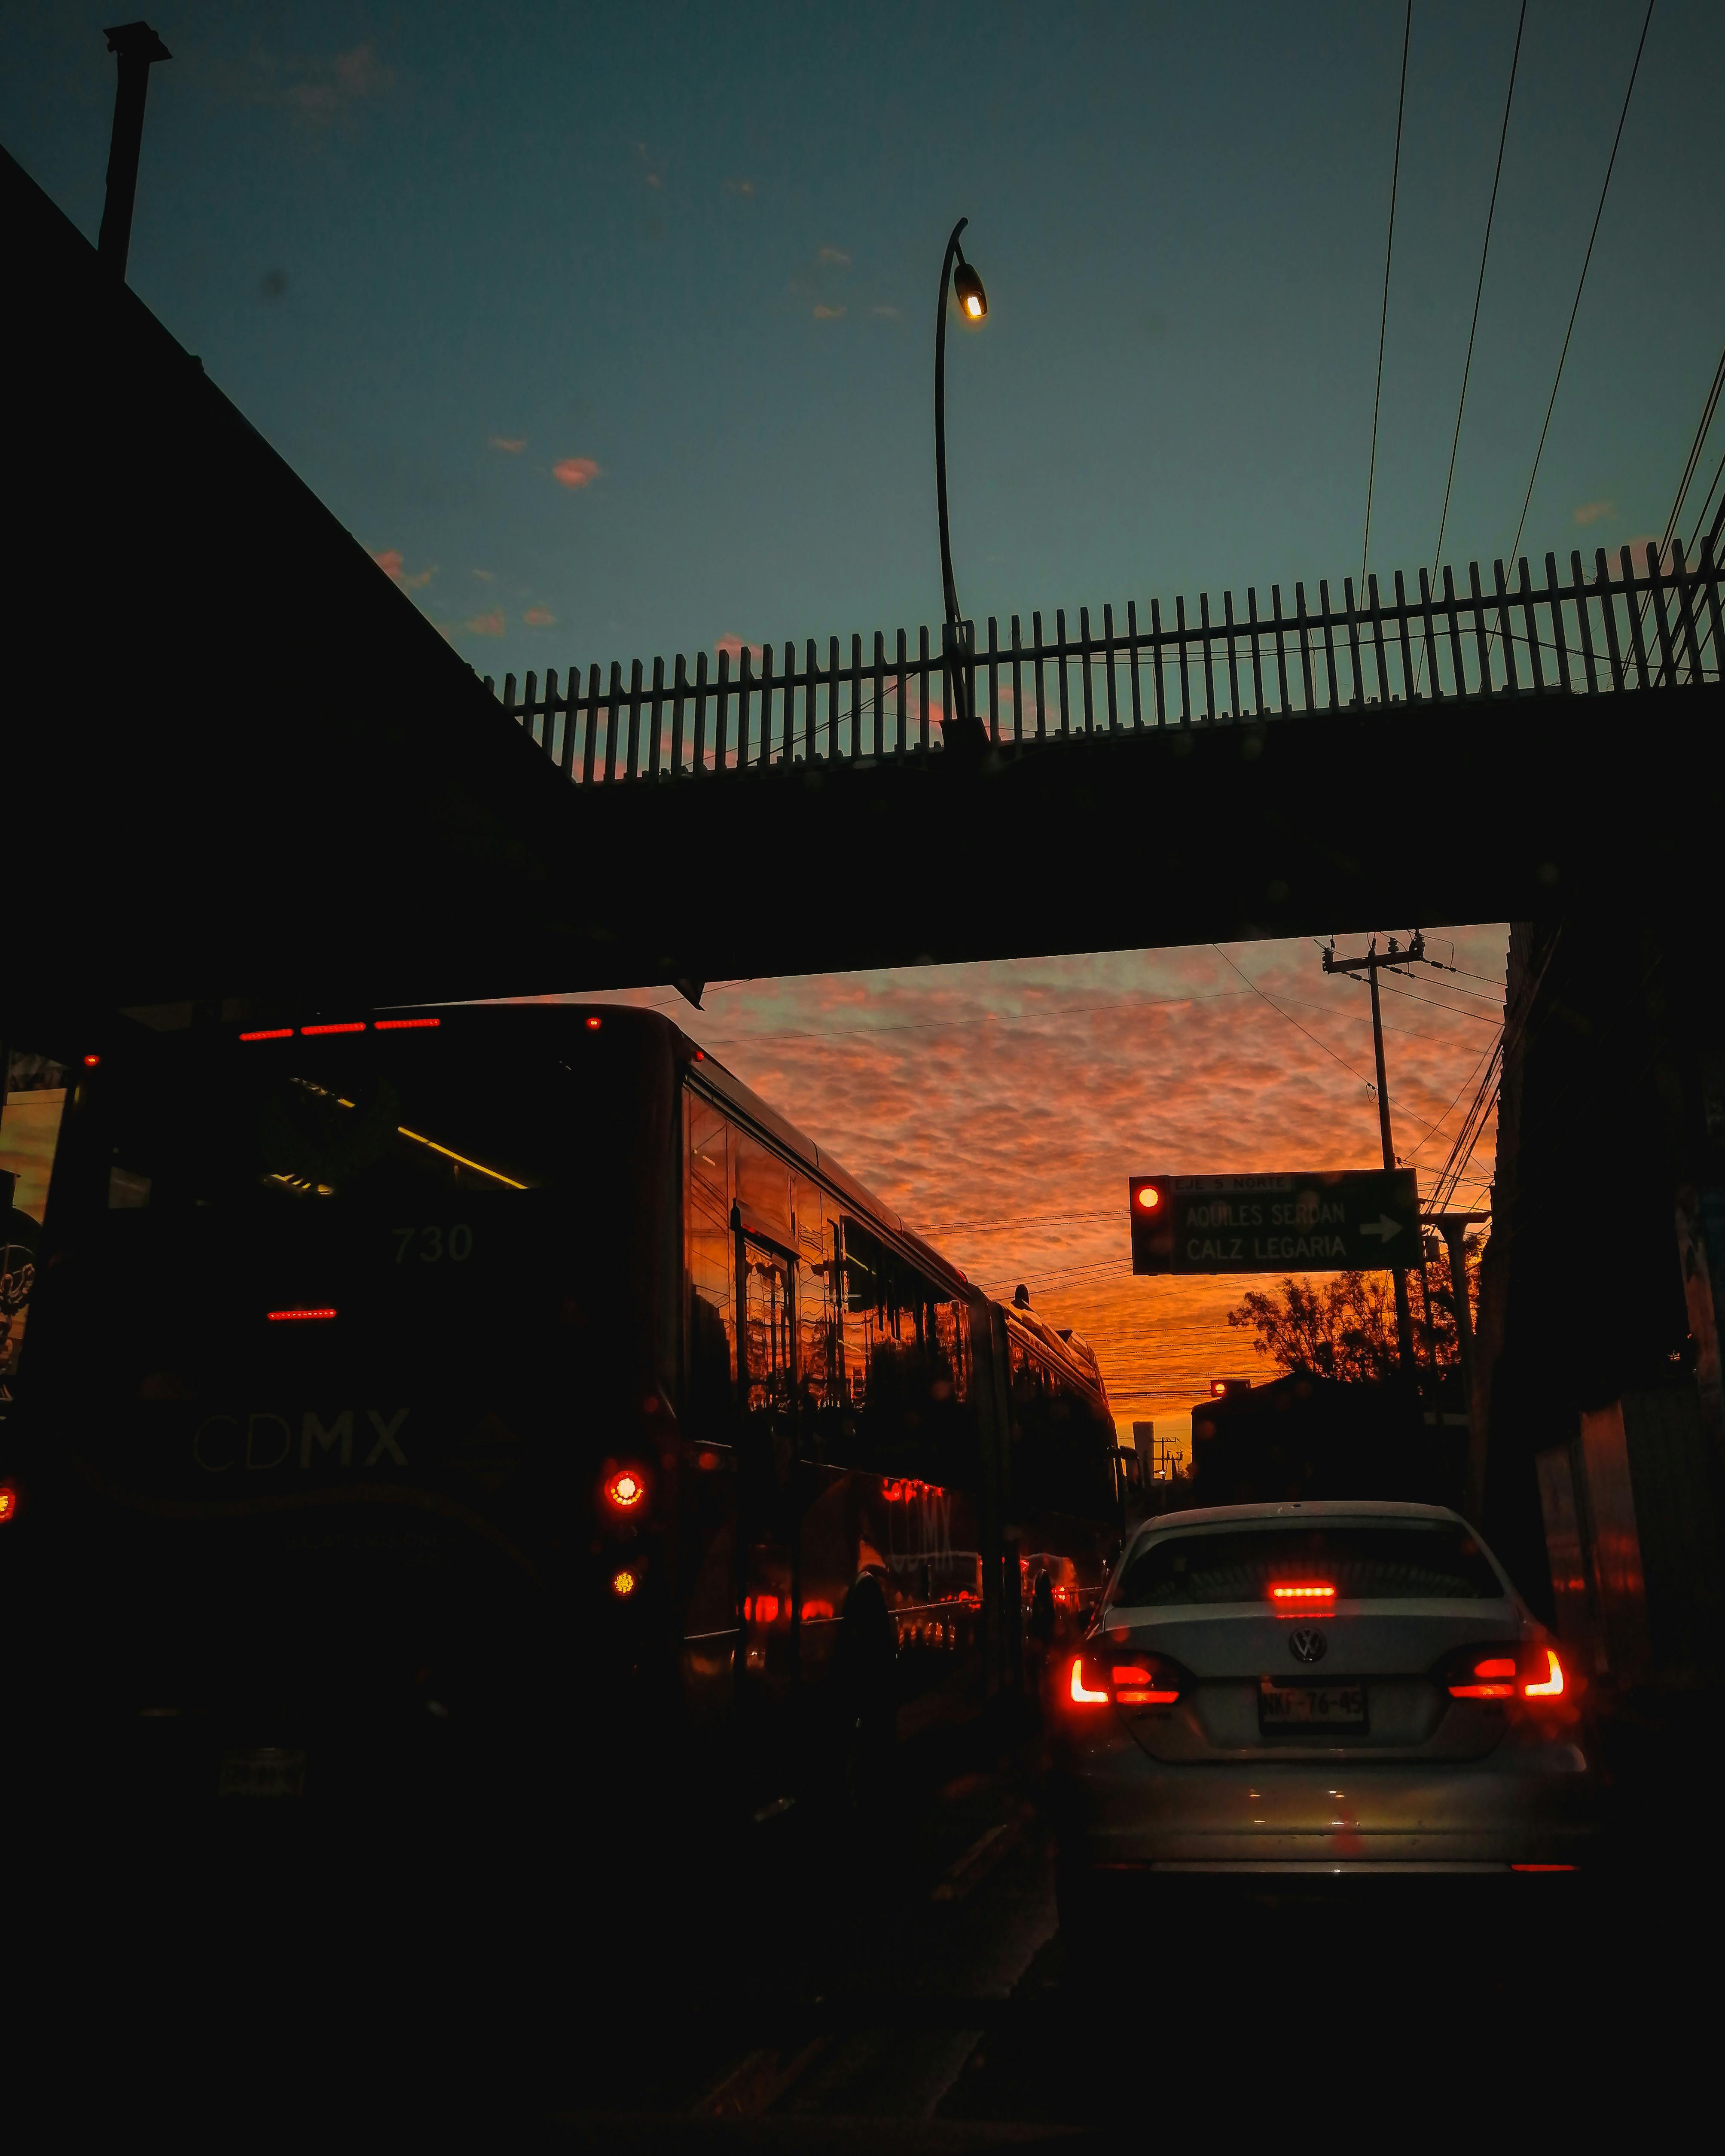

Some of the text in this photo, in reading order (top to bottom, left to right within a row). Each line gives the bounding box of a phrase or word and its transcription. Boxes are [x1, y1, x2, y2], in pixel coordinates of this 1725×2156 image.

[1175, 1177, 1285, 1190] EJE 5 NORTE
[1186, 1202, 1346, 1227] AQUILES SERDAN
[391, 1223, 474, 1265] 730
[1186, 1235, 1347, 1260] CALZ LEGARIA
[192, 1405, 411, 1473] CDMX
